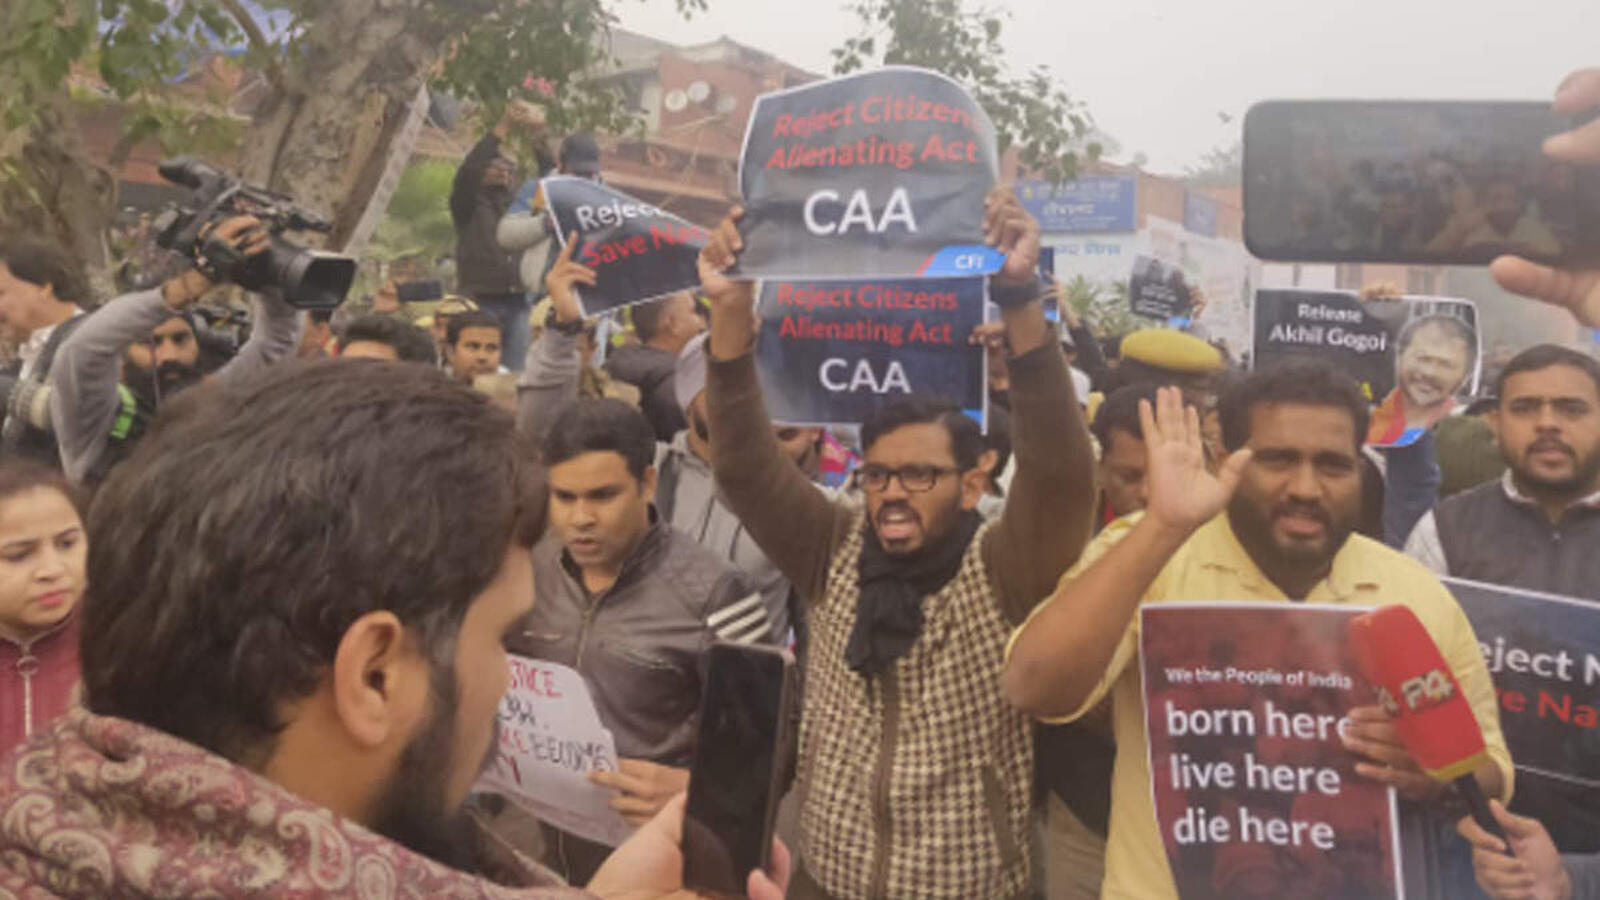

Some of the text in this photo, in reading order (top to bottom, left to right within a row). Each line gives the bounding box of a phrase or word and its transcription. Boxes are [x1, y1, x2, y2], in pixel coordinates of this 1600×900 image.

[771, 102, 856, 140] Reject
[766, 133, 978, 169] Alienating Act
[576, 199, 661, 231] Rejec
[803, 186, 918, 235] CAA
[582, 235, 647, 267] Save
[777, 283, 958, 311] Reject Citizens
[1297, 303, 1364, 323] Release
[779, 315, 954, 347] Alienating Act
[1268, 325, 1388, 353] Akhil Gogoi
[818, 358, 913, 394] CAA
[1480, 636, 1573, 682] eject
[1164, 666, 1353, 690] We the People of India
[1166, 701, 1255, 736] born
[1170, 753, 1342, 795] live here
[1174, 806, 1336, 849] die here
